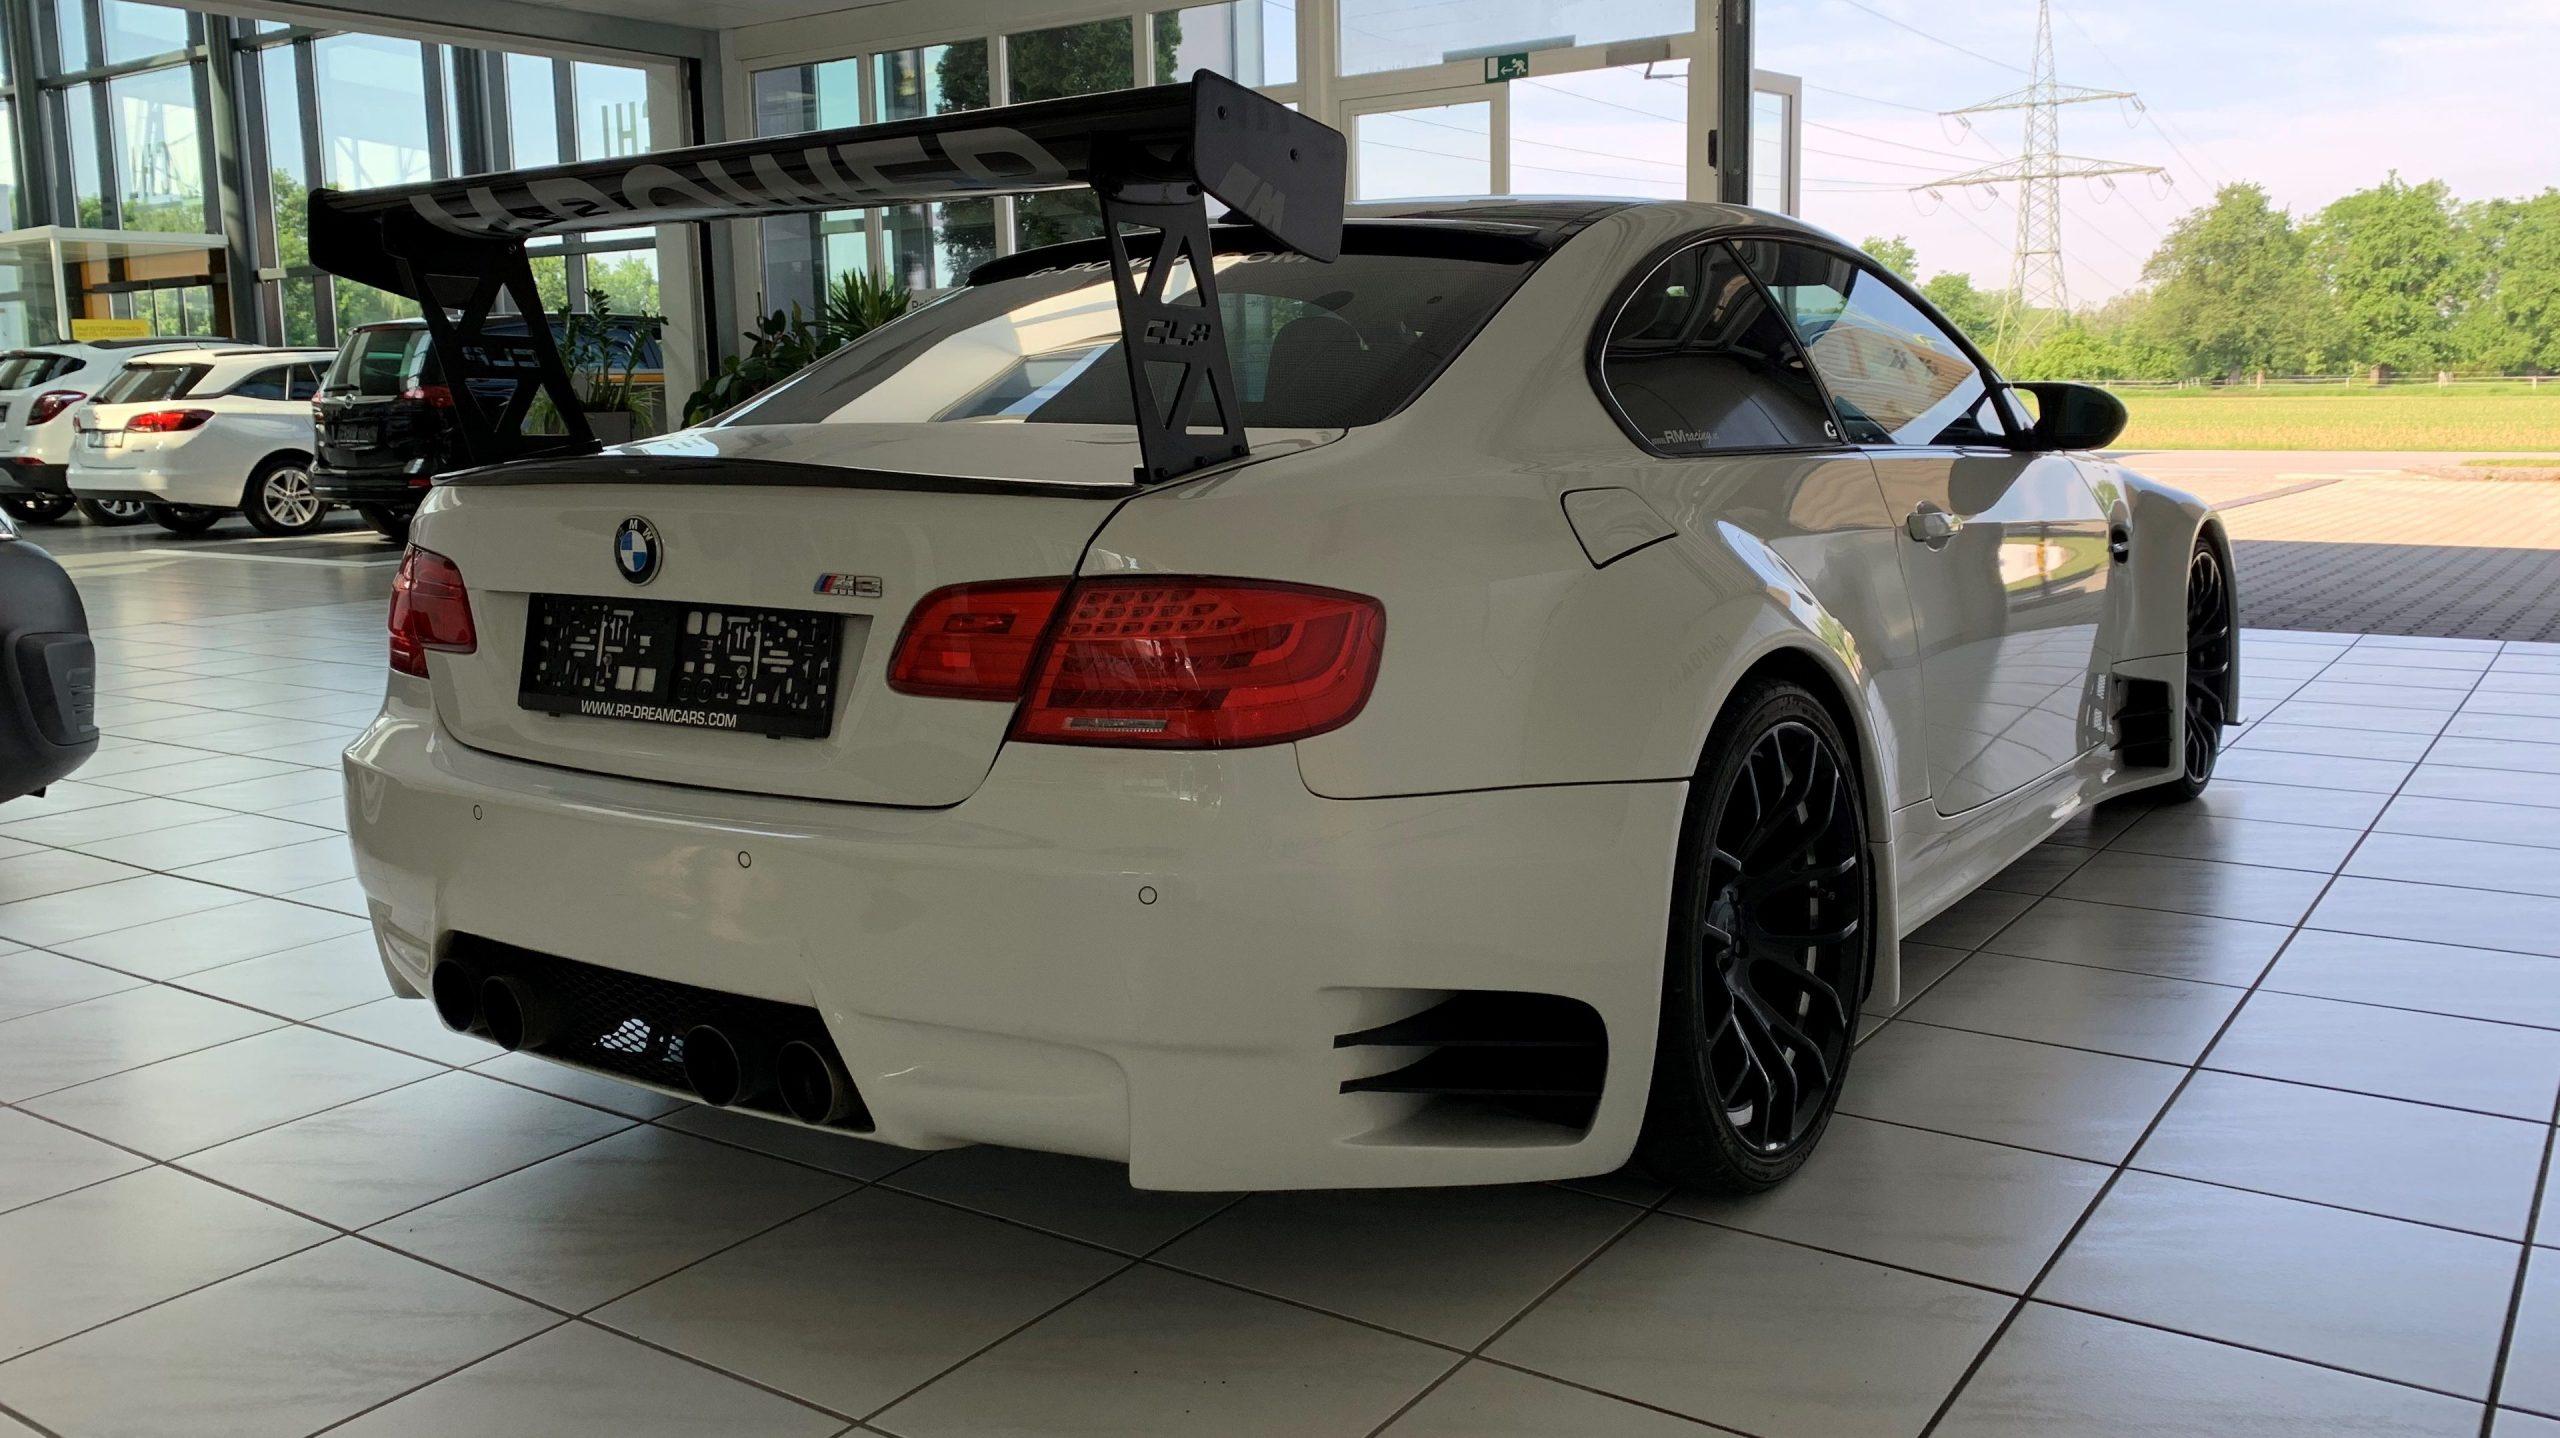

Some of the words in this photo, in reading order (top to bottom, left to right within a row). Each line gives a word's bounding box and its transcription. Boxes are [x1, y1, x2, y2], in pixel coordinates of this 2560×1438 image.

[617, 519, 654, 541] BMW
[826, 573, 882, 598] M3
[580, 699, 737, 728] WWW.RP-DREAMCARS.COM
